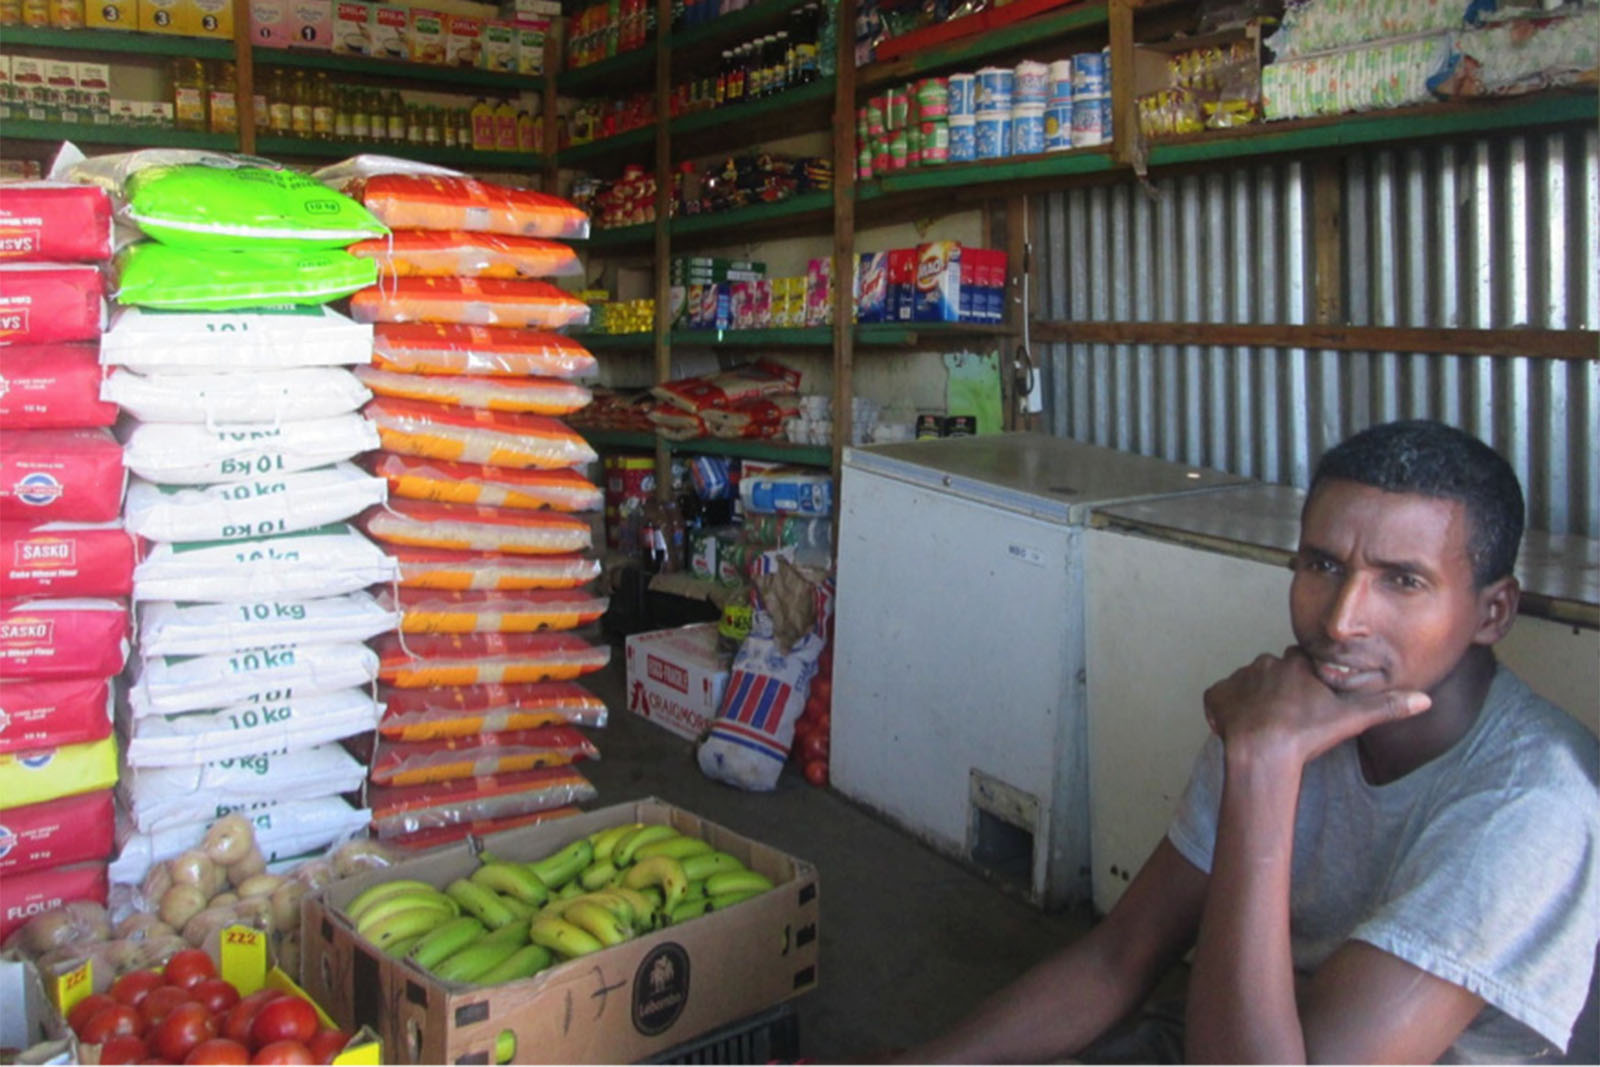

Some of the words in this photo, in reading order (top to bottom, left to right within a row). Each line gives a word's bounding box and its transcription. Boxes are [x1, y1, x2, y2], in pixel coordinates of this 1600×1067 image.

[221, 458, 251, 475] kg
[256, 455, 284, 474] 10
[23, 544, 69, 560] SASKO
[240, 604, 270, 621] 10
[274, 602, 306, 620] kg
[0, 623, 47, 640] SASKO
[229, 710, 258, 730] 10
[8, 898, 62, 919] FLOUR
